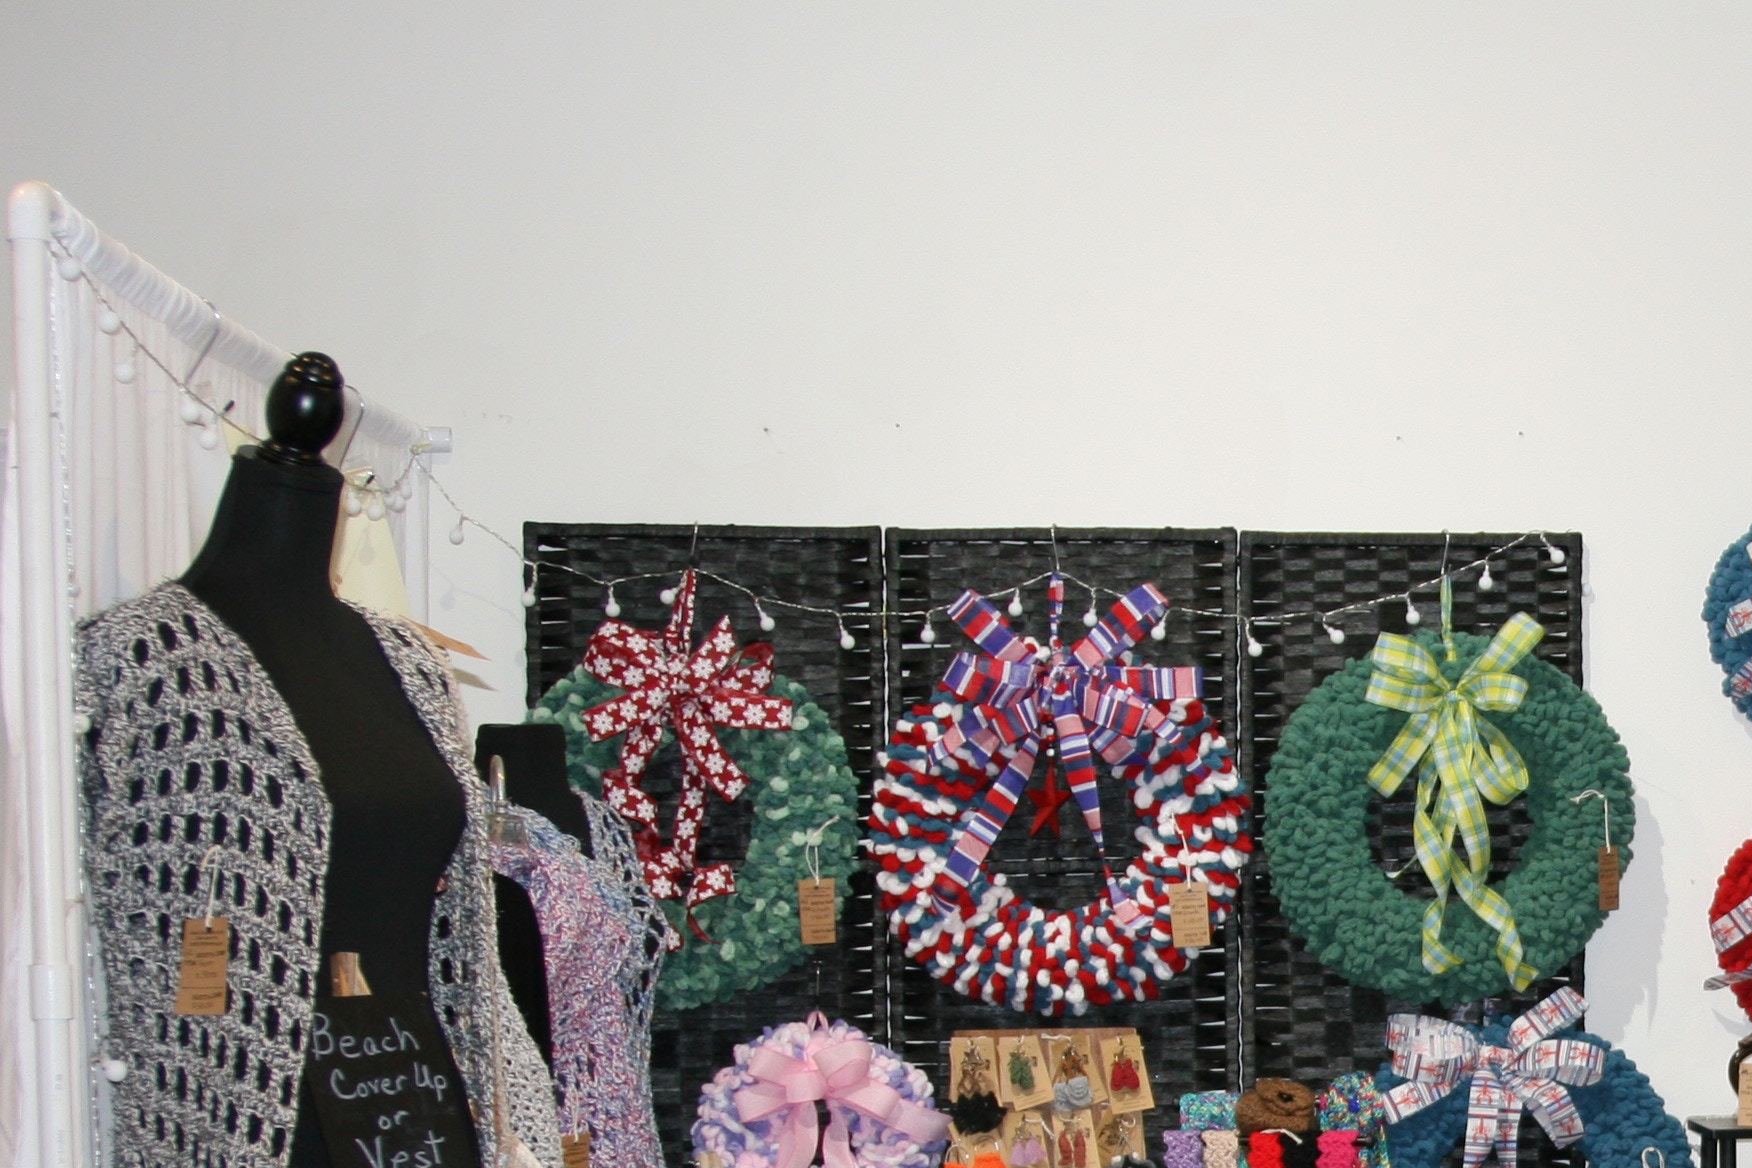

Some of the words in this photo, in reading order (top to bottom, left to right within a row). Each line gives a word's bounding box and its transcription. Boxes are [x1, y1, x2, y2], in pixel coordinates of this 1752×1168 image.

[311, 1012, 420, 1060] Beach
[330, 1068, 408, 1100] Cover
[413, 1061, 447, 1102] Up
[377, 1110, 409, 1130] or
